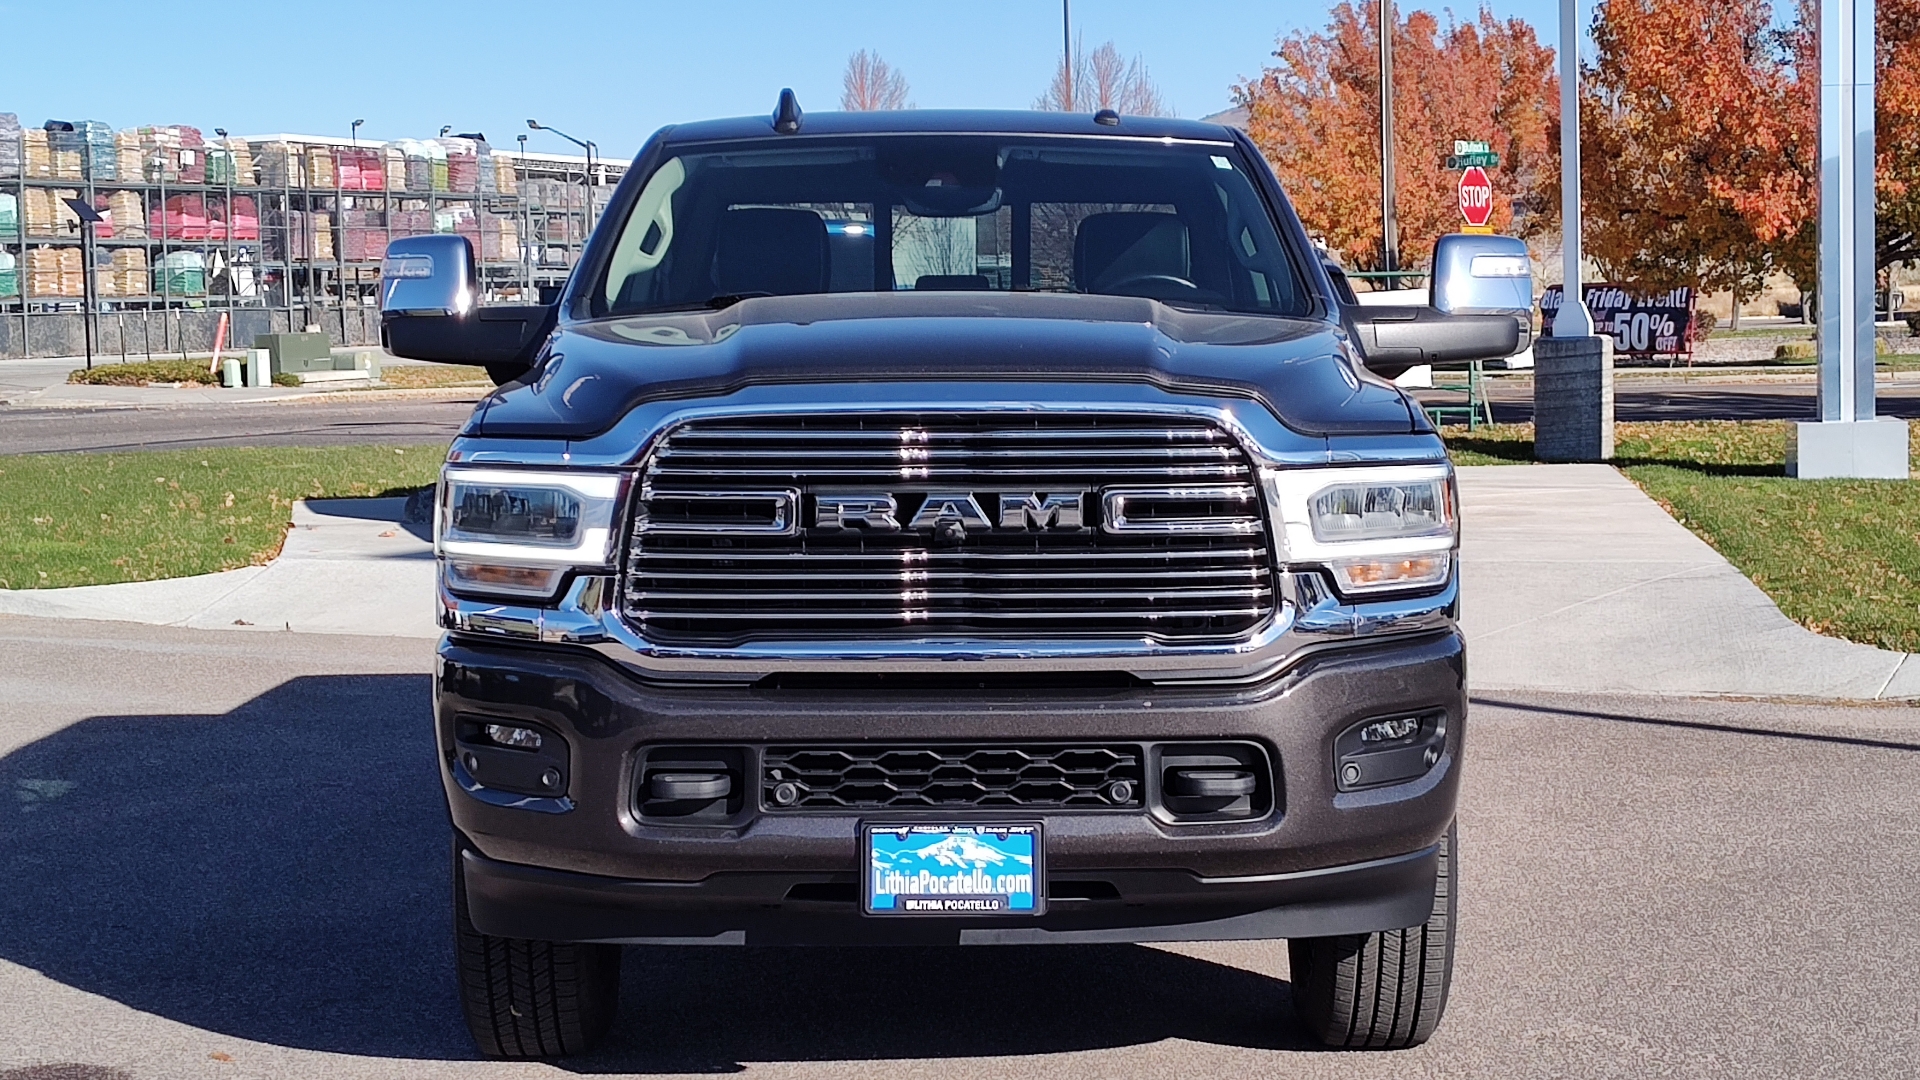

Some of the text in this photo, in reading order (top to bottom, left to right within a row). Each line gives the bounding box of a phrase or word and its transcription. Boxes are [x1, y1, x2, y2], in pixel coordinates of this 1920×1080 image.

[1461, 185, 1489, 207] STOP
[1586, 288, 1632, 310] Friday
[1614, 312, 1675, 351] 50%
[814, 491, 1085, 530] RAM
[875, 869, 1031, 894] LithiaPocatello.com
[944, 899, 999, 910] POCATELLO
